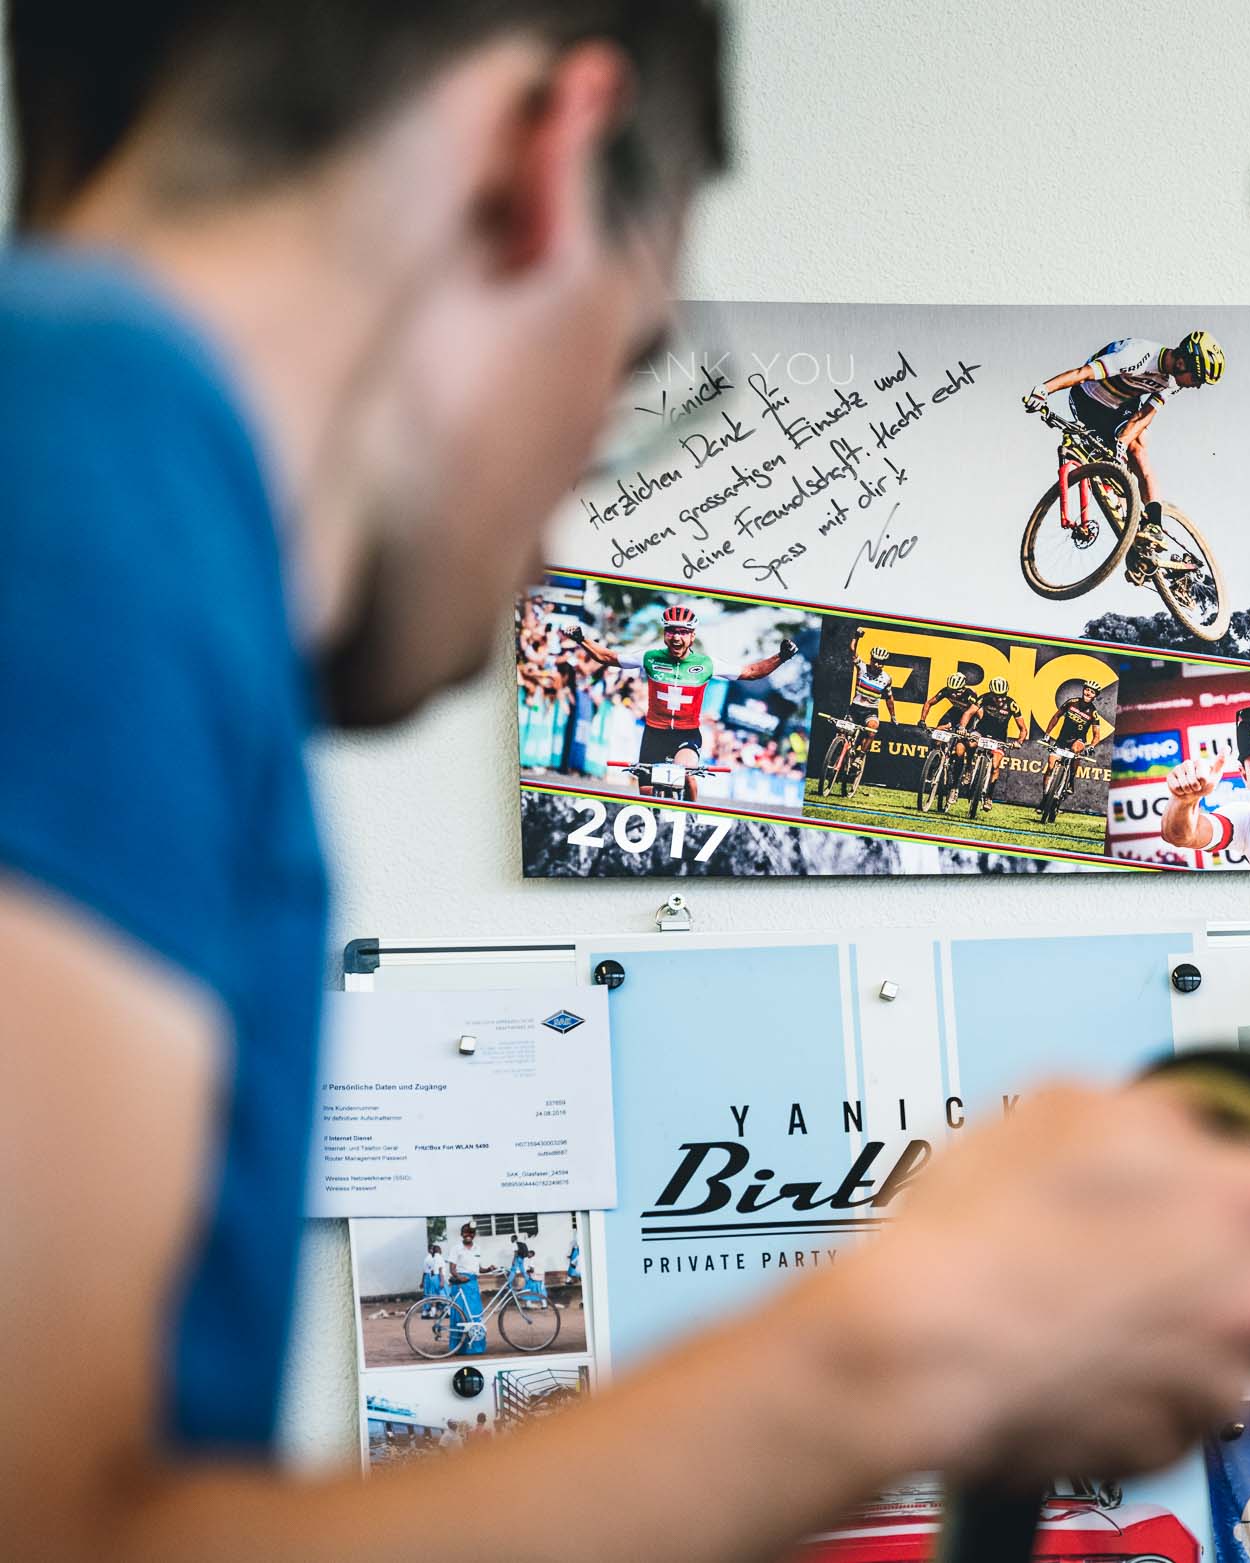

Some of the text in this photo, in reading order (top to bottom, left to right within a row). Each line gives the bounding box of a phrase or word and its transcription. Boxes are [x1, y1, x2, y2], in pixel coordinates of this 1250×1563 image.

[634, 366, 735, 427] Yanick
[751, 352, 855, 386] YOU
[580, 373, 791, 531] Herzlichen Dank für
[610, 351, 918, 568] deinen grossartigen Einsatz und
[682, 538, 736, 579] deine
[932, 361, 982, 403] echt
[742, 541, 808, 590] Spass
[818, 499, 850, 537] mit
[851, 626, 1120, 743] EPIC
[567, 797, 733, 863] 2017
[329, 1083, 373, 1091] Persönliche
[414, 1083, 447, 1092] Zugänge
[643, 1248, 838, 1275] PRIVATE PARTY
